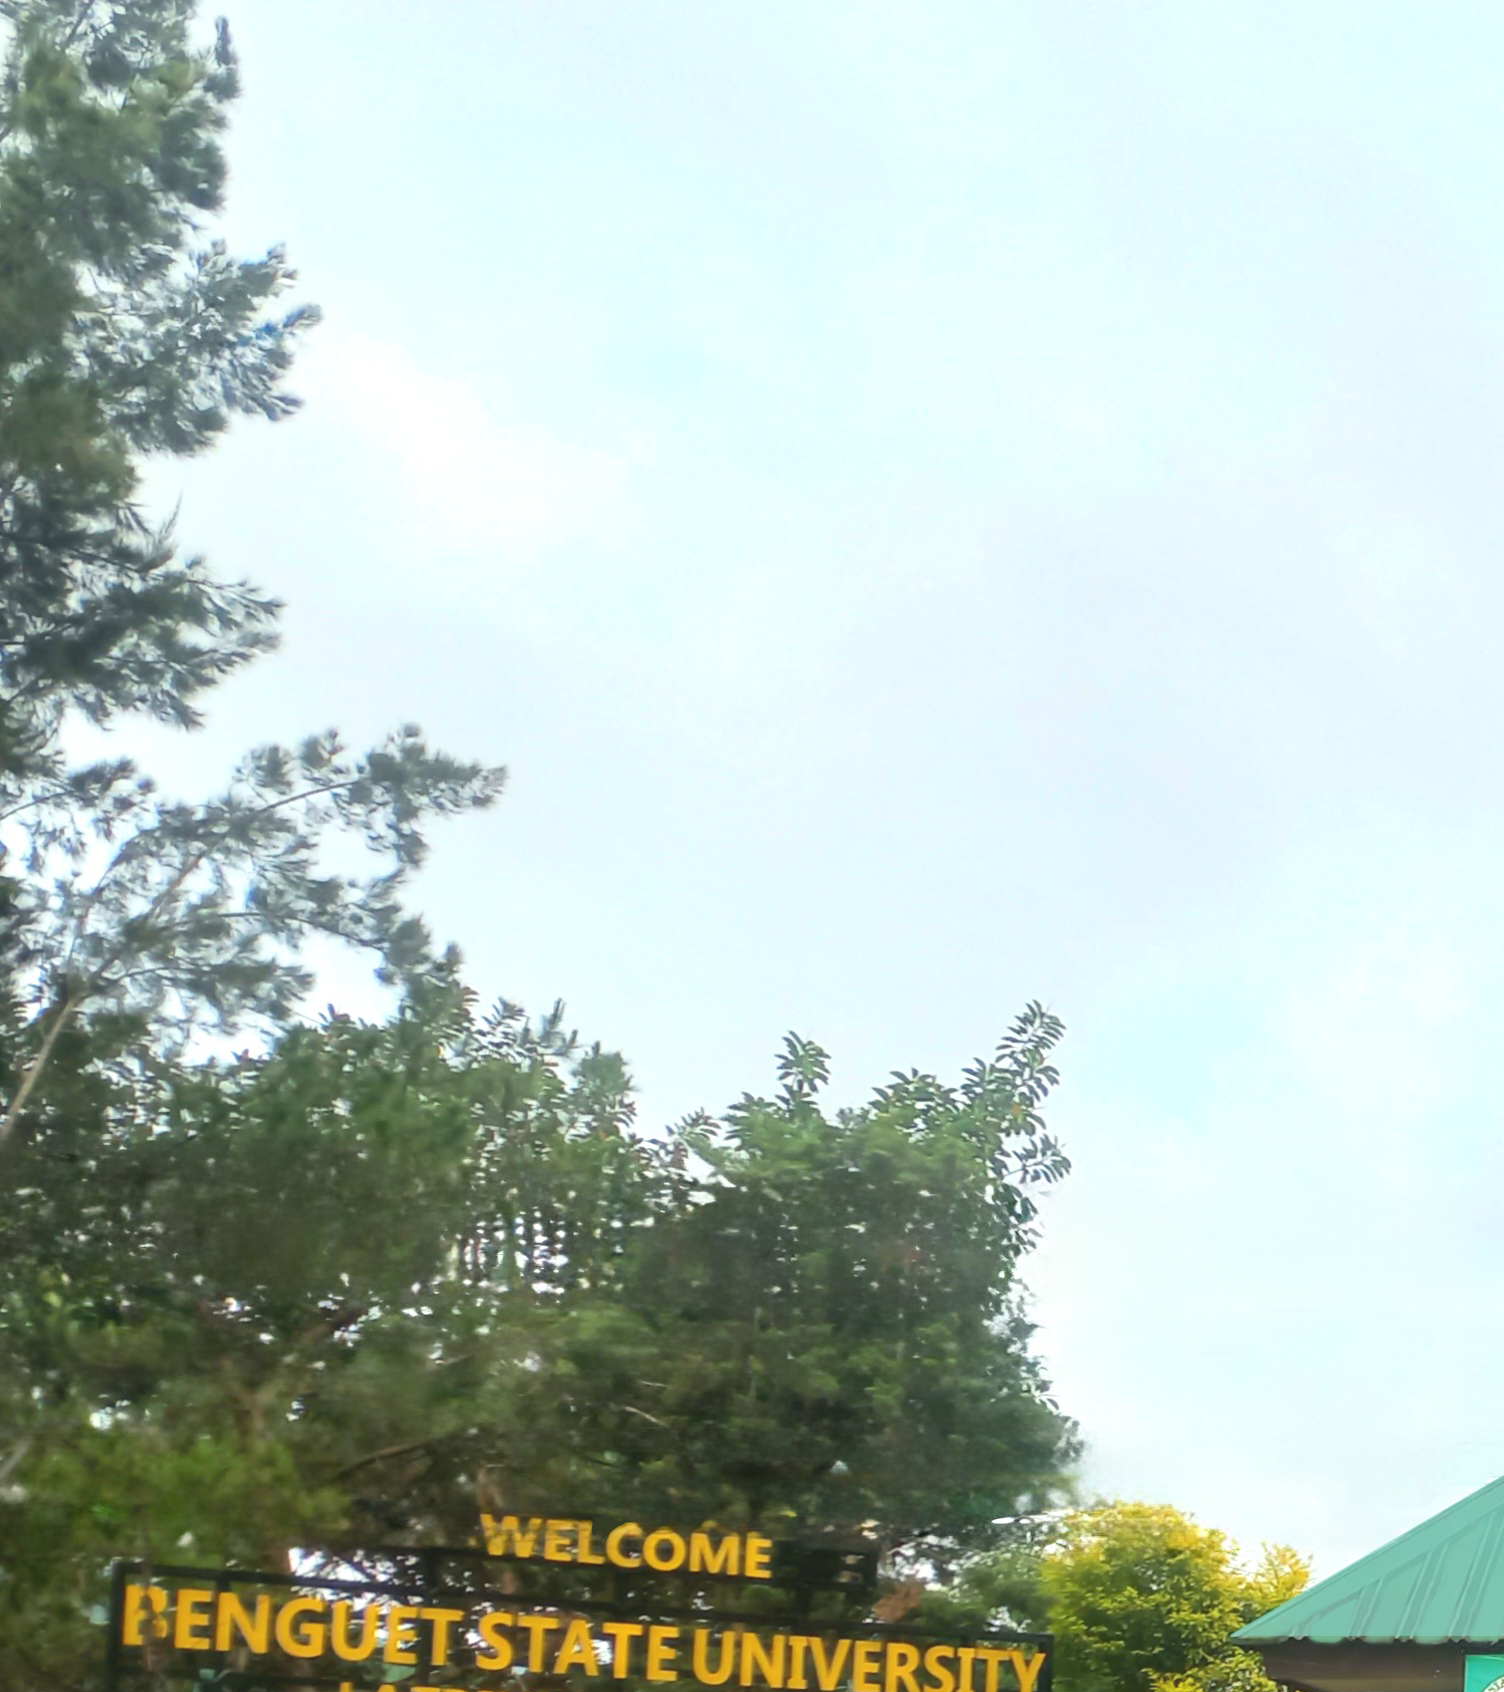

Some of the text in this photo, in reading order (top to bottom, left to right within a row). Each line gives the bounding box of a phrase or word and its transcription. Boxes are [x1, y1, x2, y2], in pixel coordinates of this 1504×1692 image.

[480, 1512, 772, 1580] WELCOME
[122, 1583, 464, 1667] BENGUET
[476, 1610, 679, 1683] STATE
